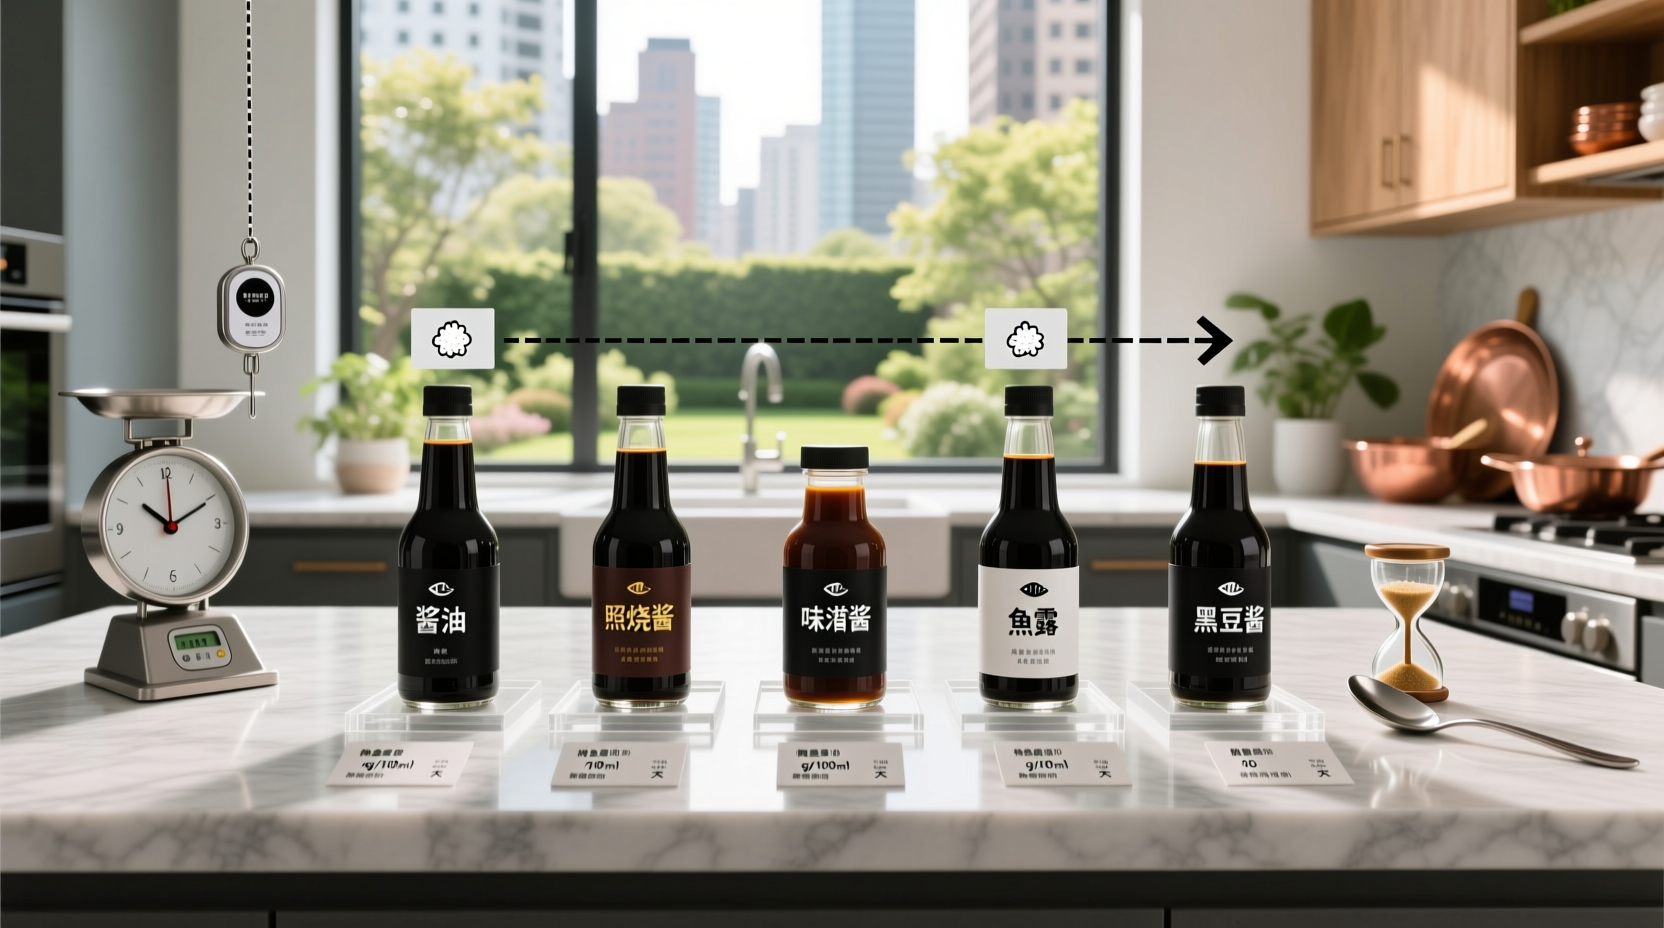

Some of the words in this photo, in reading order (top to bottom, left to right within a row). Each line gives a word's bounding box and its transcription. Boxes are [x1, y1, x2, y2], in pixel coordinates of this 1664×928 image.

[161, 467, 172, 479] 12
[116, 523, 124, 535] 9
[214, 518, 221, 529] 3
[169, 569, 177, 583] 6
[416, 605, 466, 634] 酱油
[605, 604, 674, 632] 照烧酱
[1008, 607, 1058, 636] 魚露
[1194, 605, 1264, 633] 黑豆酱
[801, 761, 849, 772] g/100ml
